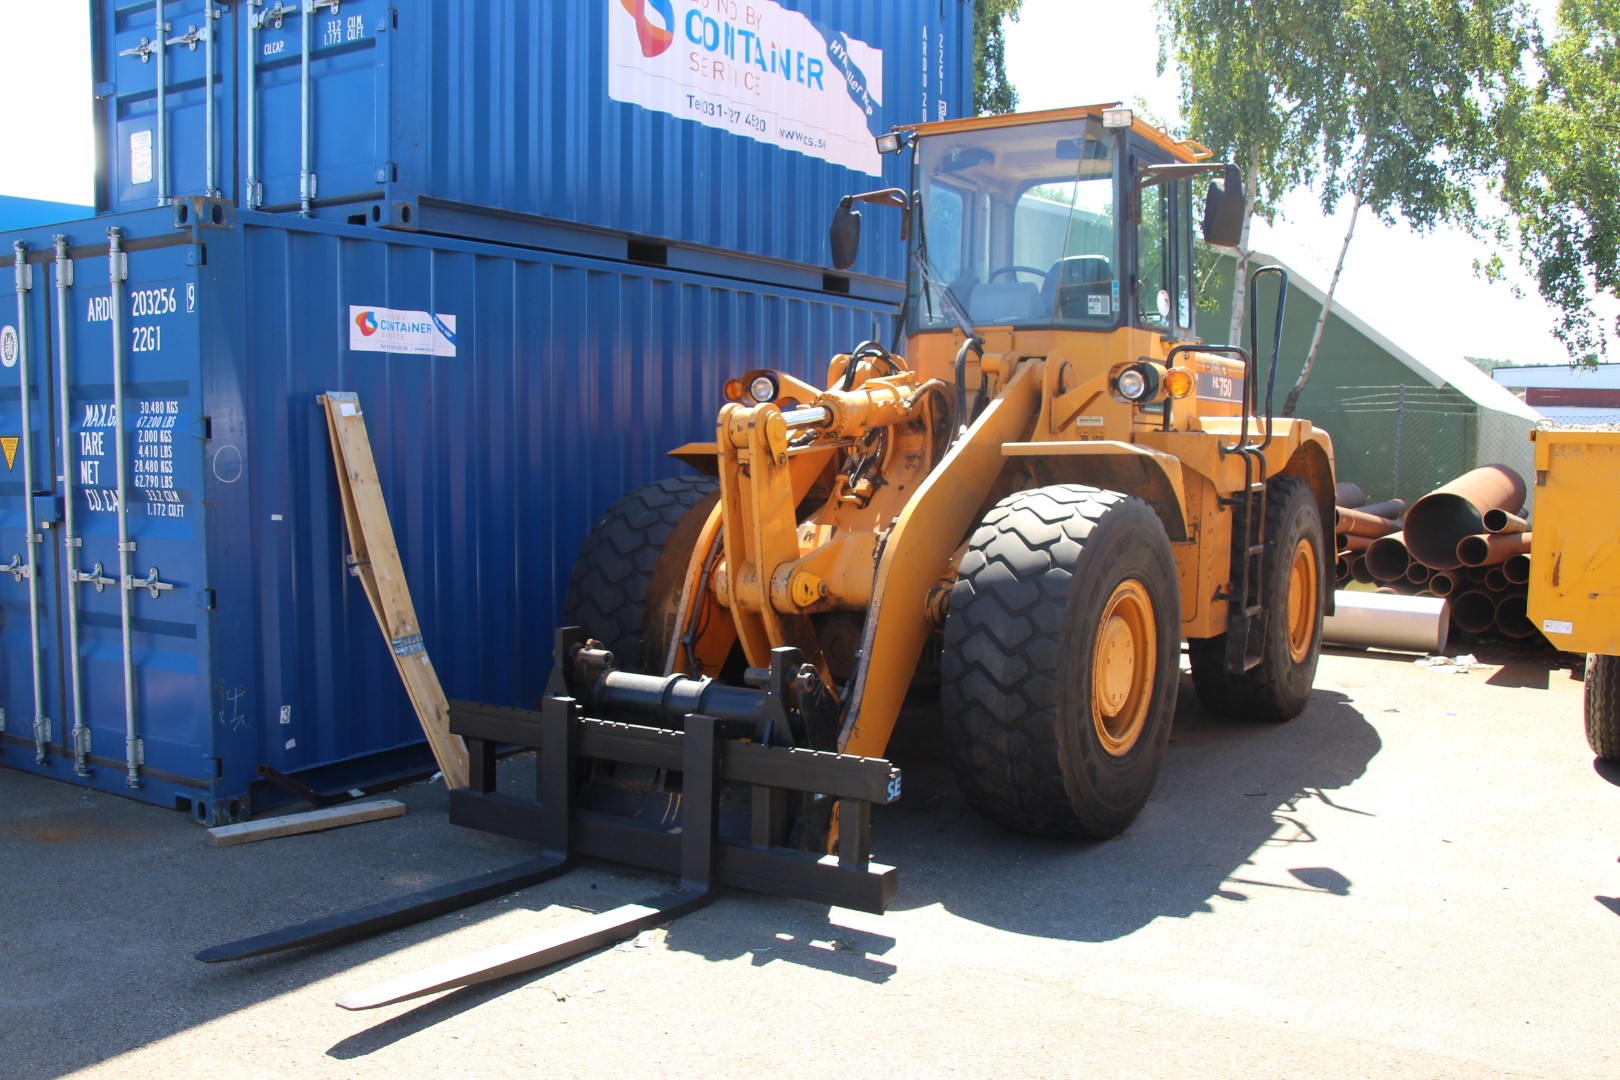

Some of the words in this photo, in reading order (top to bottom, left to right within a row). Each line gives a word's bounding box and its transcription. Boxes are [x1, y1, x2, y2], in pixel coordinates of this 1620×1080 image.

[327, 20, 342, 33] 33.2
[323, 32, 342, 46] 1.173
[131, 287, 177, 317] 203256
[132, 325, 161, 352] 22G1
[83, 404, 117, 428] MAX.G
[140, 401, 165, 414] 30.480
[166, 401, 179, 414] KGS
[136, 416, 162, 428] 67.200
[162, 416, 177, 428] LBS
[80, 432, 105, 456] TARE
[138, 430, 158, 443] 2.000
[160, 430, 172, 443] KGS
[138, 445, 159, 458] 4.410
[160, 445, 173, 458] LBS
[80, 461, 100, 485] NET
[134, 460, 159, 473] 28.480
[160, 460, 173, 473] KGS
[135, 475, 159, 488] 62.790
[161, 475, 173, 488] LBS
[147, 503, 166, 516] 1.172
